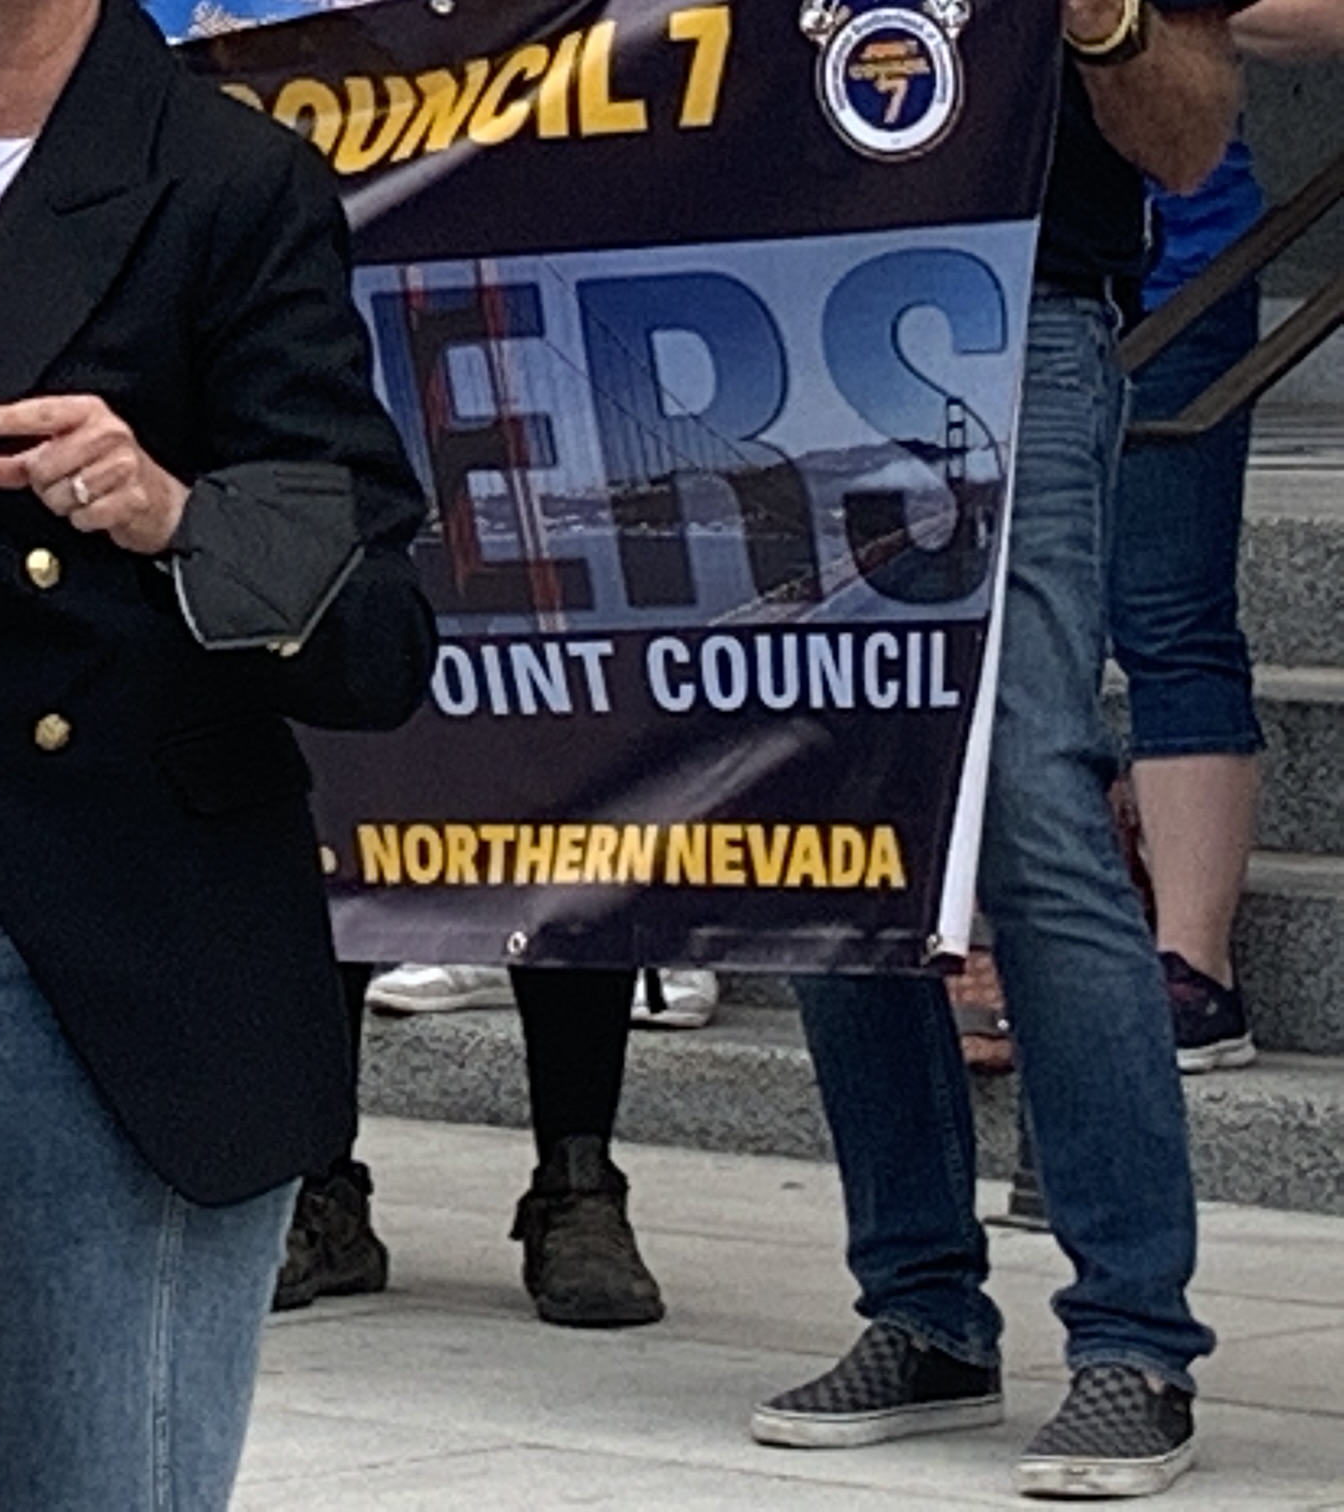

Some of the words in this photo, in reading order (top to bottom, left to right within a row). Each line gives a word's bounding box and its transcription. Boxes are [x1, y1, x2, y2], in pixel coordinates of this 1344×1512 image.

[219, 20, 648, 176] OUNCIL
[670, 5, 731, 129] 7
[645, 629, 959, 713] COUNCIL
[355, 821, 658, 886] NORTHERN
[663, 822, 907, 888] NEVADA
